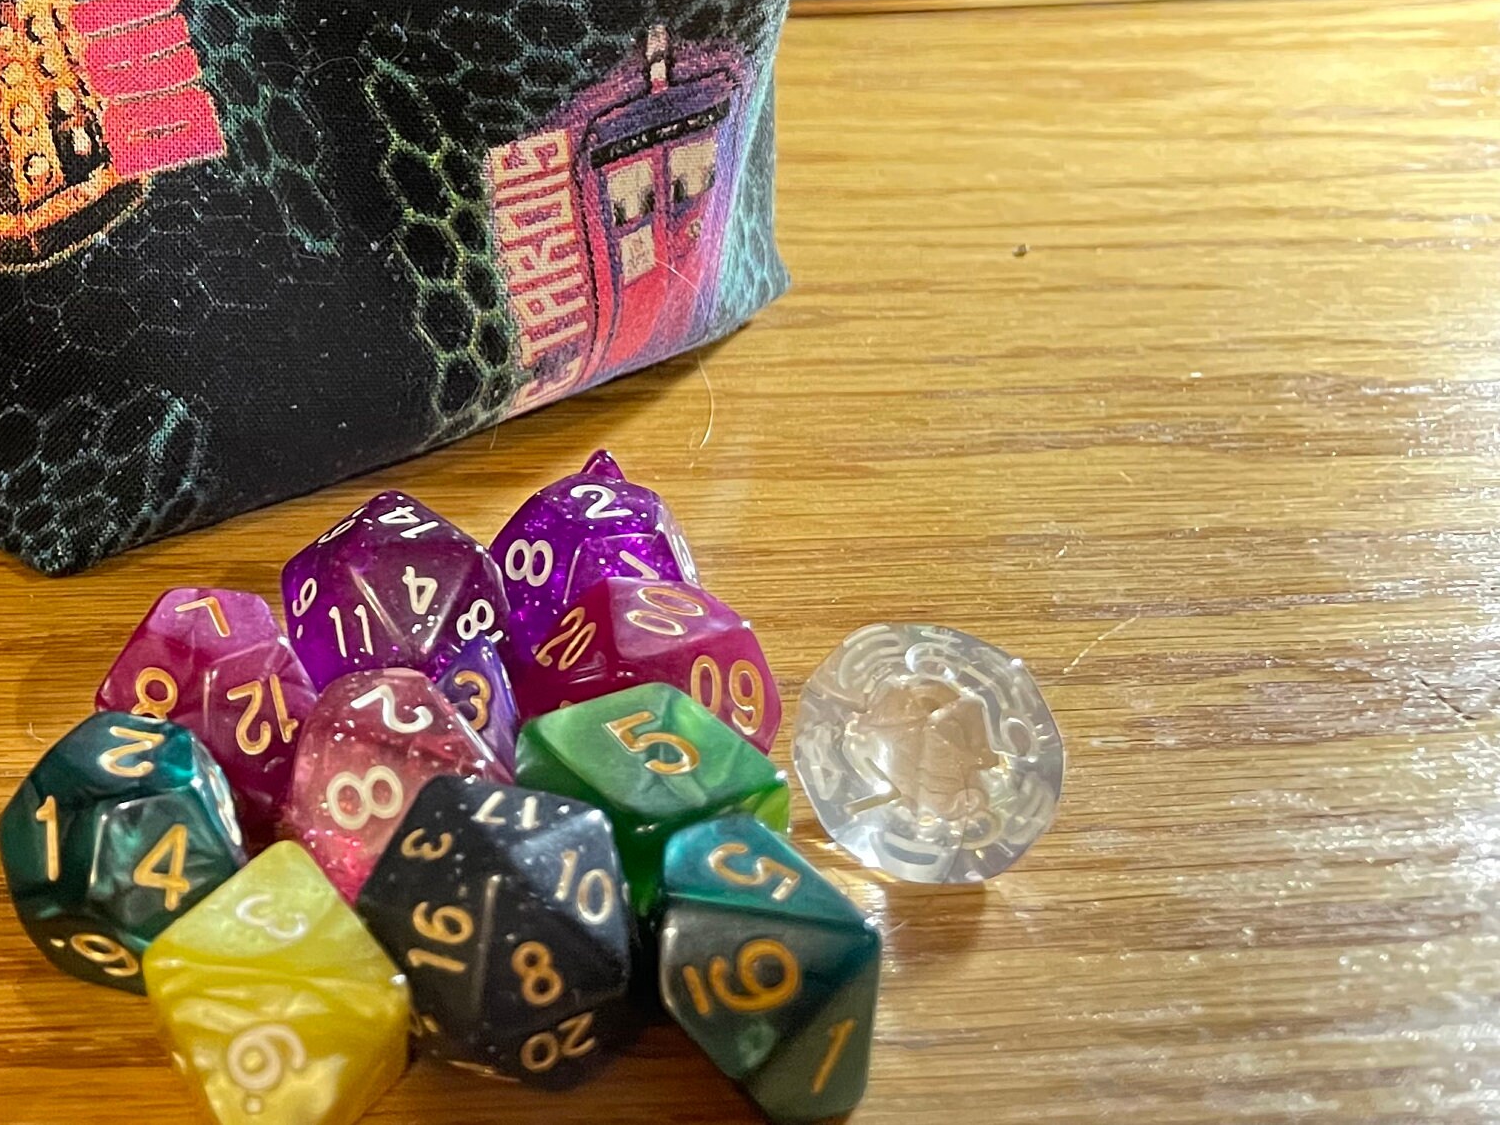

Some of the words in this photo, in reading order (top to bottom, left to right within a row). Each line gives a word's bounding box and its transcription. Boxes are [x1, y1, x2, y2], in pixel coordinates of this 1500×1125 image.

[486, 129, 591, 369] TARDIS
[378, 505, 439, 539] 14
[570, 484, 633, 519] 2
[402, 565, 438, 615] 4
[505, 539, 554, 587] 8
[175, 596, 231, 638] 7
[329, 604, 374, 658] 11
[535, 606, 597, 671] 20
[626, 586, 708, 636] 00
[227, 674, 299, 756] 12
[350, 684, 434, 733] 2
[454, 669, 491, 730] 3
[97, 725, 165, 778] 2
[604, 710, 699, 775] 5
[326, 765, 403, 830] 8
[470, 790, 541, 832] 17
[36, 795, 60, 882] 1
[134, 823, 190, 912] 4
[400, 827, 453, 862] 3
[554, 849, 615, 925] 10
[707, 843, 801, 902] 5
[235, 894, 308, 940] 3
[407, 901, 475, 975] 16
[511, 940, 564, 1007] 8
[519, 1011, 596, 1073] 20
[811, 1018, 857, 1095] 1
